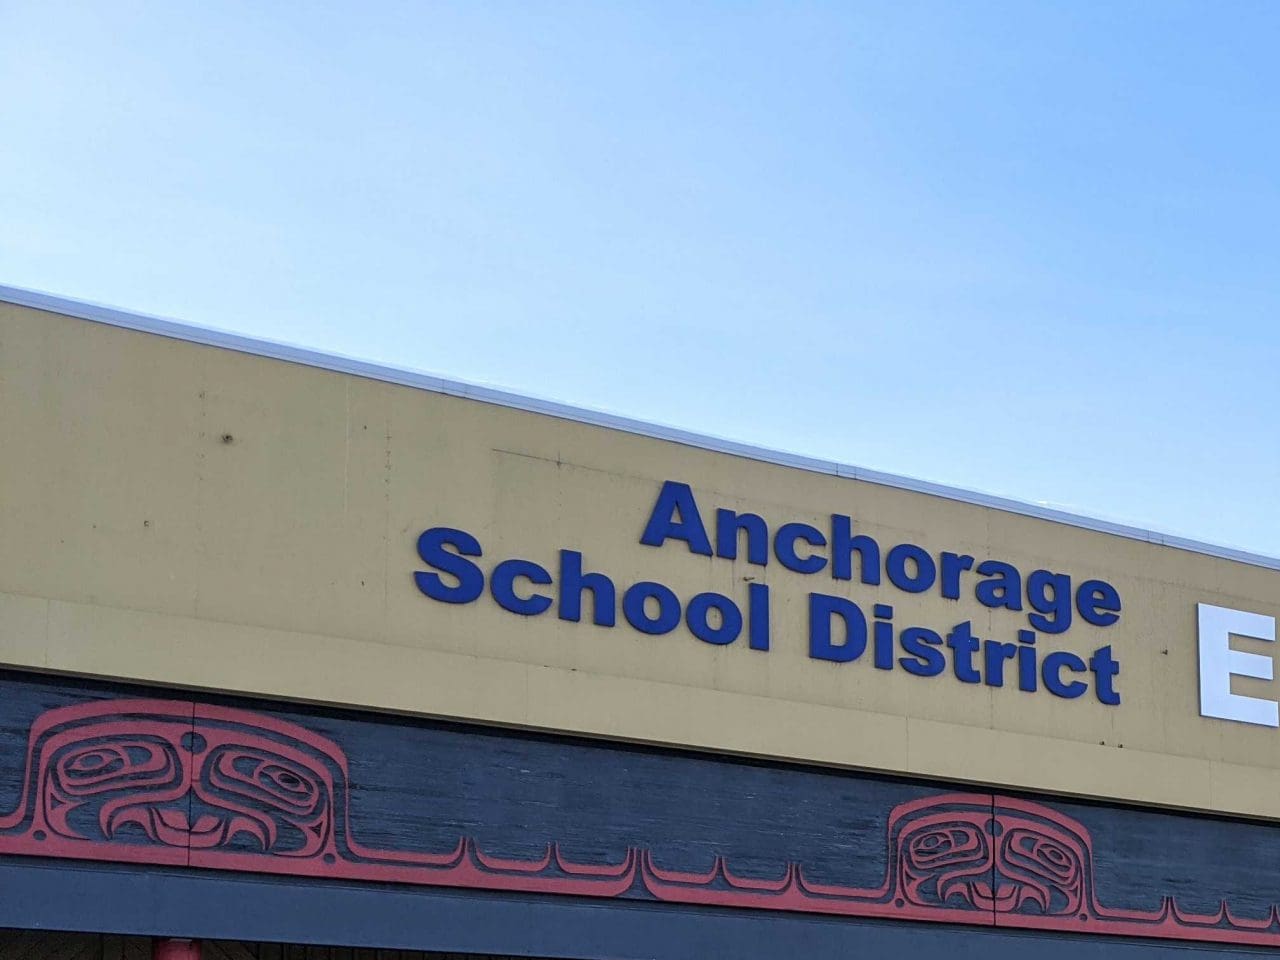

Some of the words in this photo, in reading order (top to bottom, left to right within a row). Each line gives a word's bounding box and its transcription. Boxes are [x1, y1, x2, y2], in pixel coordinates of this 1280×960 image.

[414, 527, 769, 651] School
[809, 592, 1121, 705] District
[639, 481, 1121, 634] Anchorage
